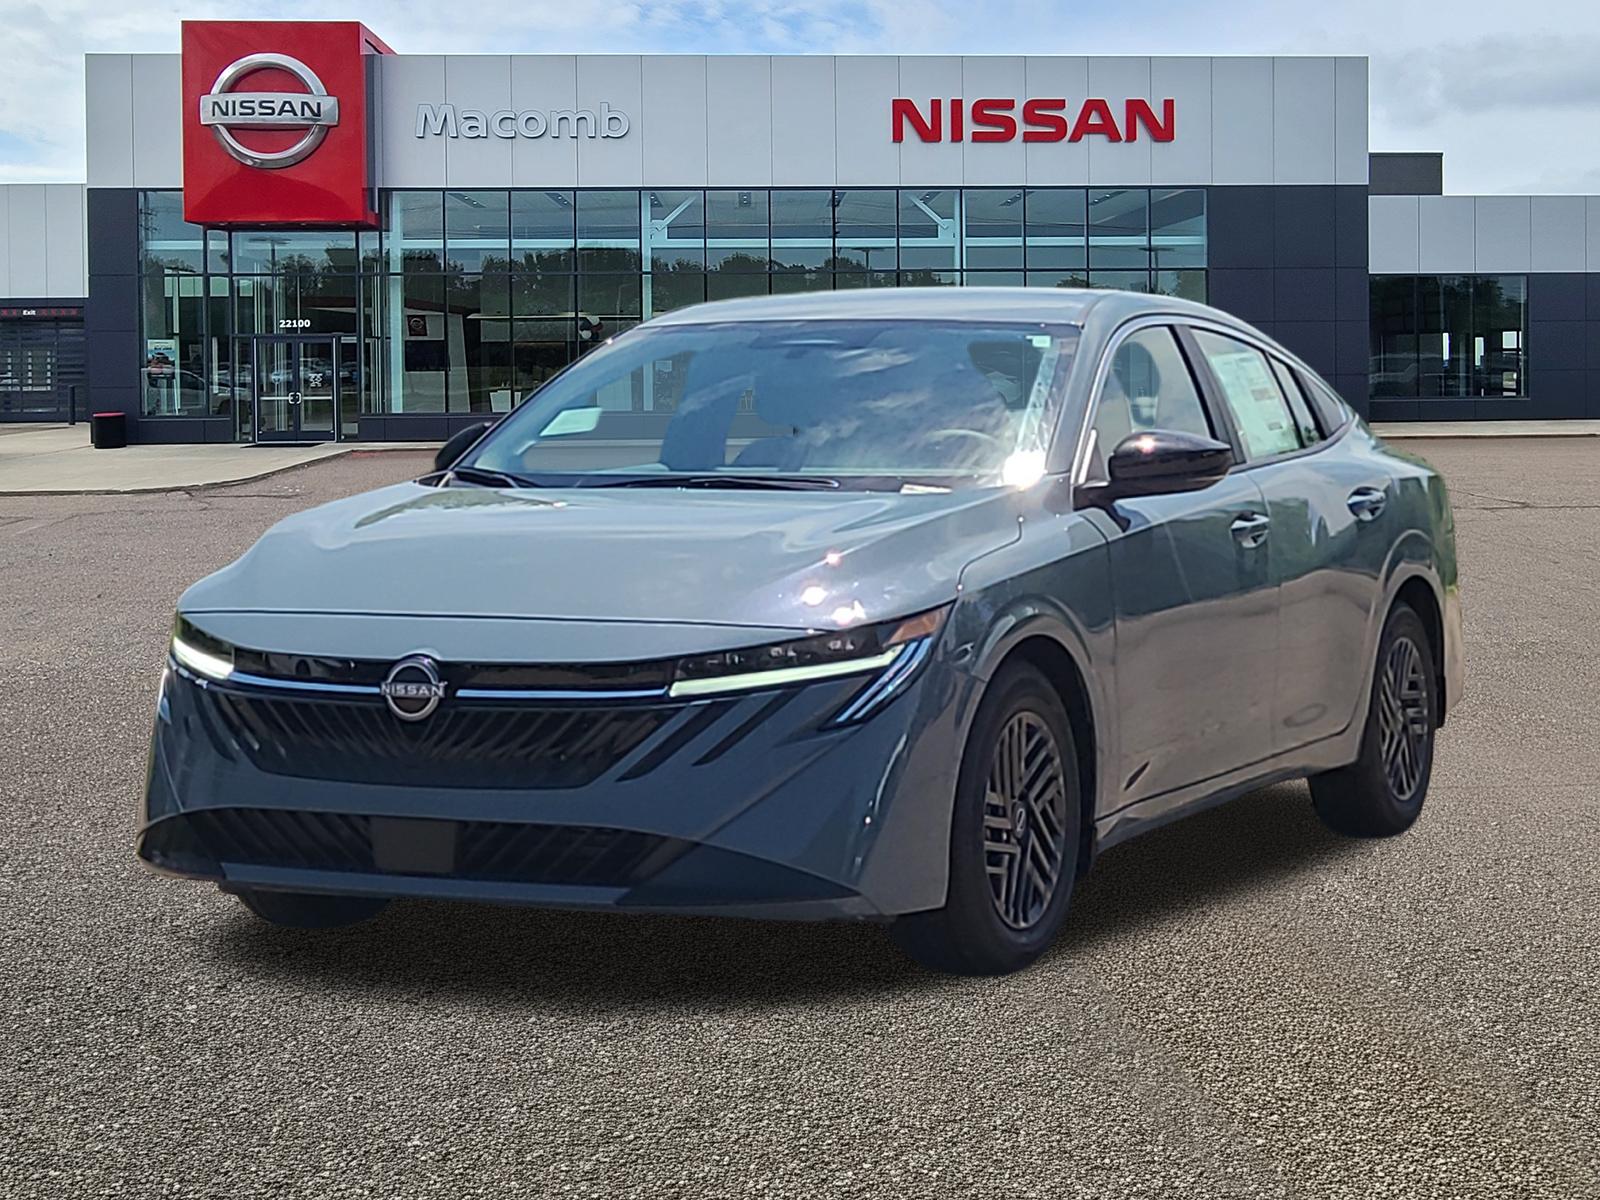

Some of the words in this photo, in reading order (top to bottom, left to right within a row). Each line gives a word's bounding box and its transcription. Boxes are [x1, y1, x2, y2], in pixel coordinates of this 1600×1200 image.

[211, 100, 322, 118] NISSAN
[415, 101, 630, 139] Macomb
[892, 98, 1175, 143] NISSAN
[279, 319, 311, 328] 22100
[381, 682, 446, 698] NISSAN
